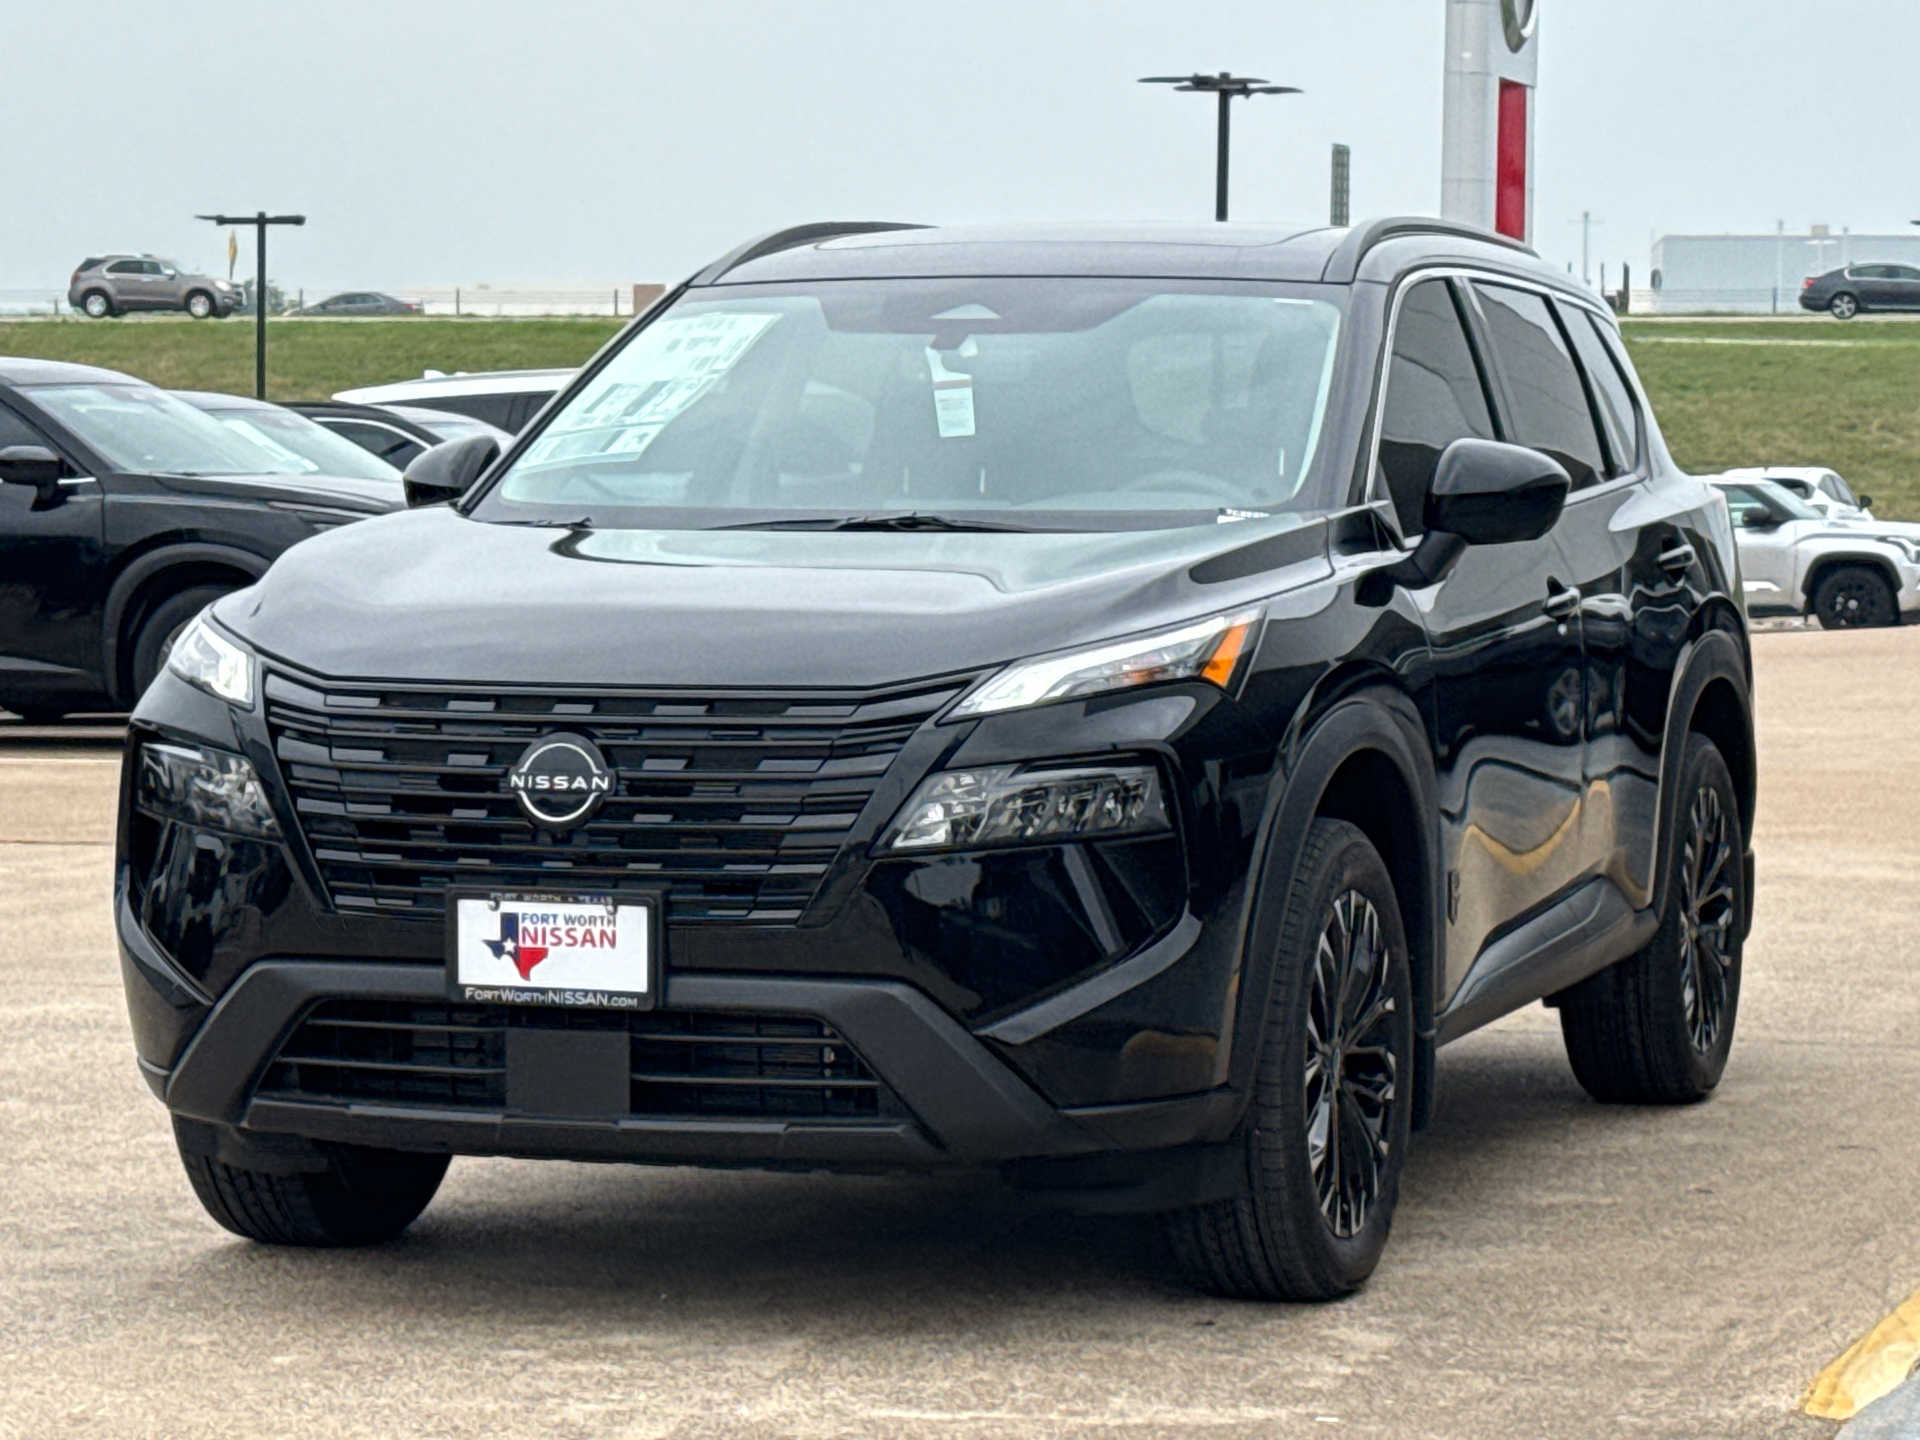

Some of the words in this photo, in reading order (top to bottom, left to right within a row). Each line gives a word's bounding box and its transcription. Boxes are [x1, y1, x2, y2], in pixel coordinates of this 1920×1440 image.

[510, 774, 609, 790] NISSAN
[490, 892, 518, 900] FORT
[523, 893, 562, 902] WORTH
[577, 895, 613, 905] TEXAS
[521, 912, 559, 925] FORT
[563, 914, 617, 928] WORTH
[521, 926, 617, 949] NISSAN
